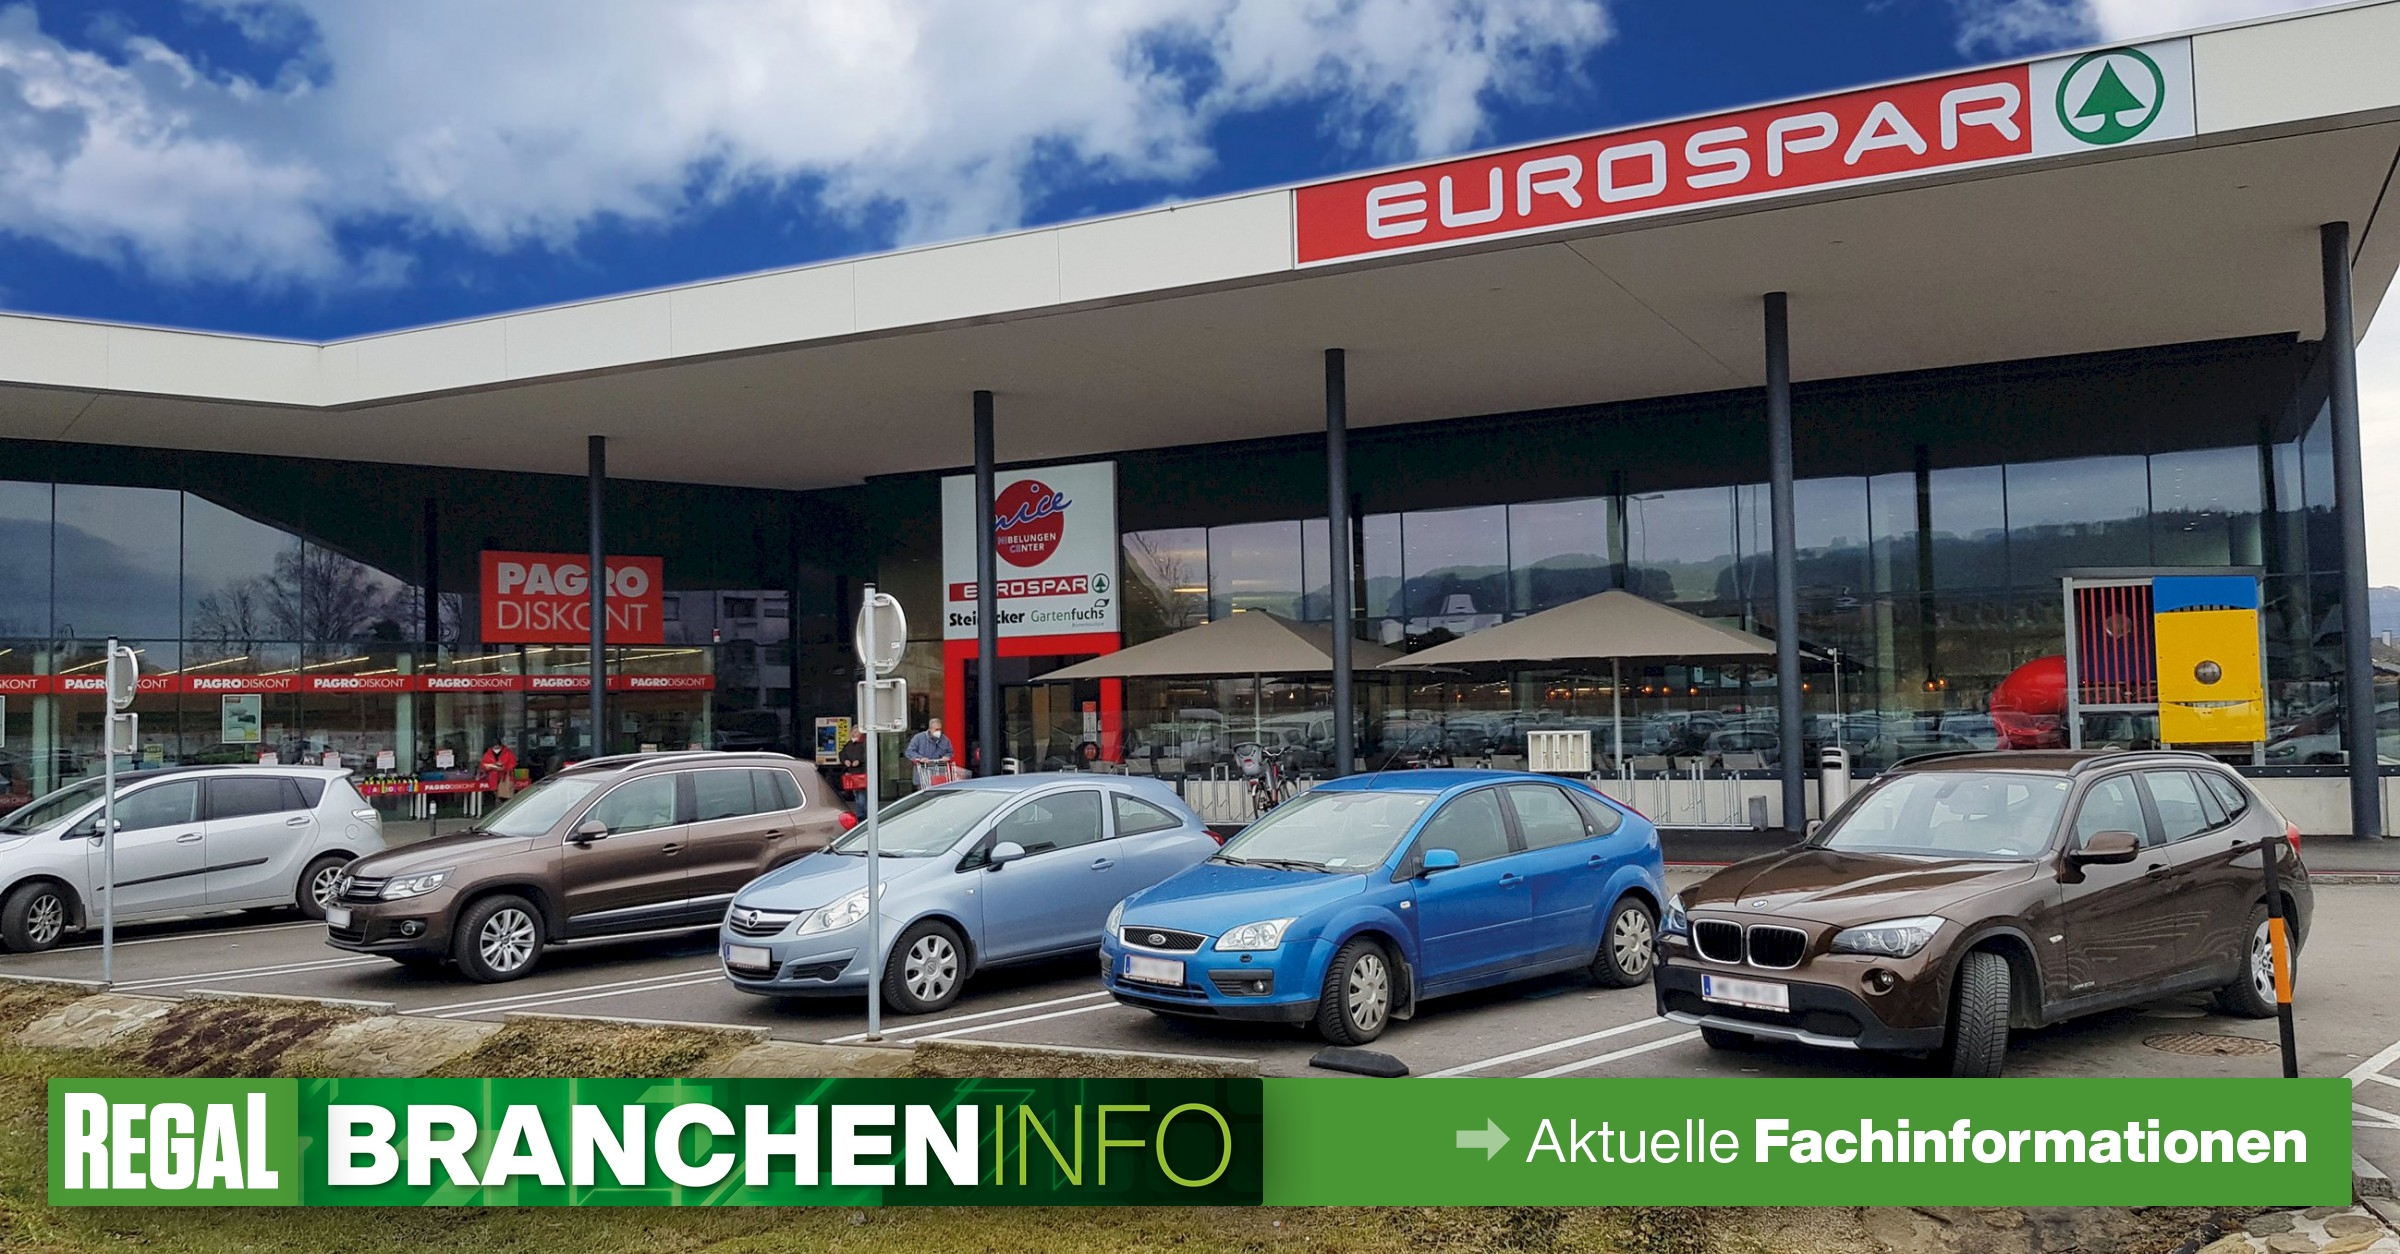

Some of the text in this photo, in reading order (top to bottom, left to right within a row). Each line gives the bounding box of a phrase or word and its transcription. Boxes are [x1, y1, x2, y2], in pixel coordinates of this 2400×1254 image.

[1366, 81, 2020, 239] EUROSPAR
[1009, 543, 1045, 553] CENTER
[963, 577, 1087, 599] EROSPAR
[949, 607, 1105, 627] Steiker Gartenfuchs
[193, 678, 290, 689] PAGRODISKONT
[313, 677, 405, 689] PAGRODISKONT
[428, 678, 514, 688] PAGRODISKONT
[532, 677, 612, 688] PAGRODISKT
[630, 677, 706, 688] PAGRODISKONT
